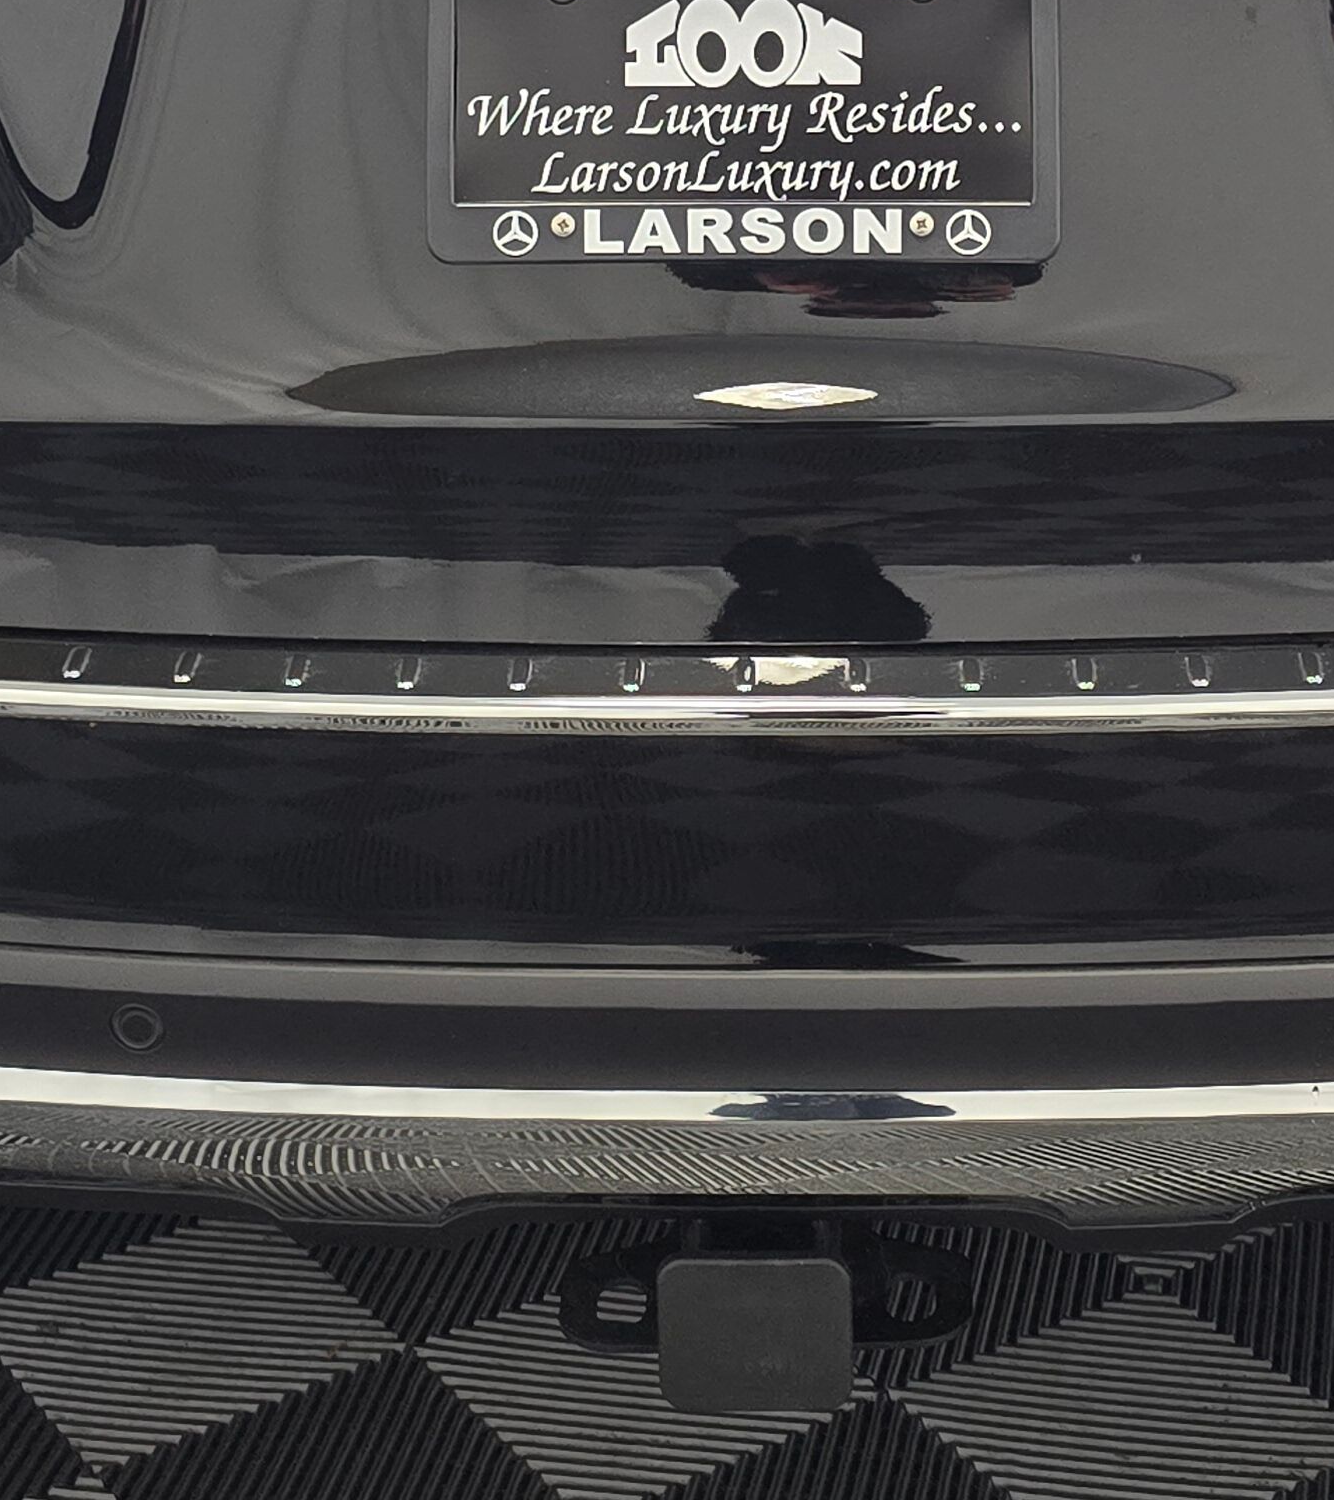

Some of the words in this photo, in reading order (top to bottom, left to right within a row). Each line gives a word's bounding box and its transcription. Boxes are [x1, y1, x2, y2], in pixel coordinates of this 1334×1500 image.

[467, 88, 614, 137] Where
[624, 92, 792, 153] Luxury
[805, 85, 1022, 143] Resides...
[530, 150, 962, 202] LarsonLuxury.com
[583, 207, 903, 254] LARSON
